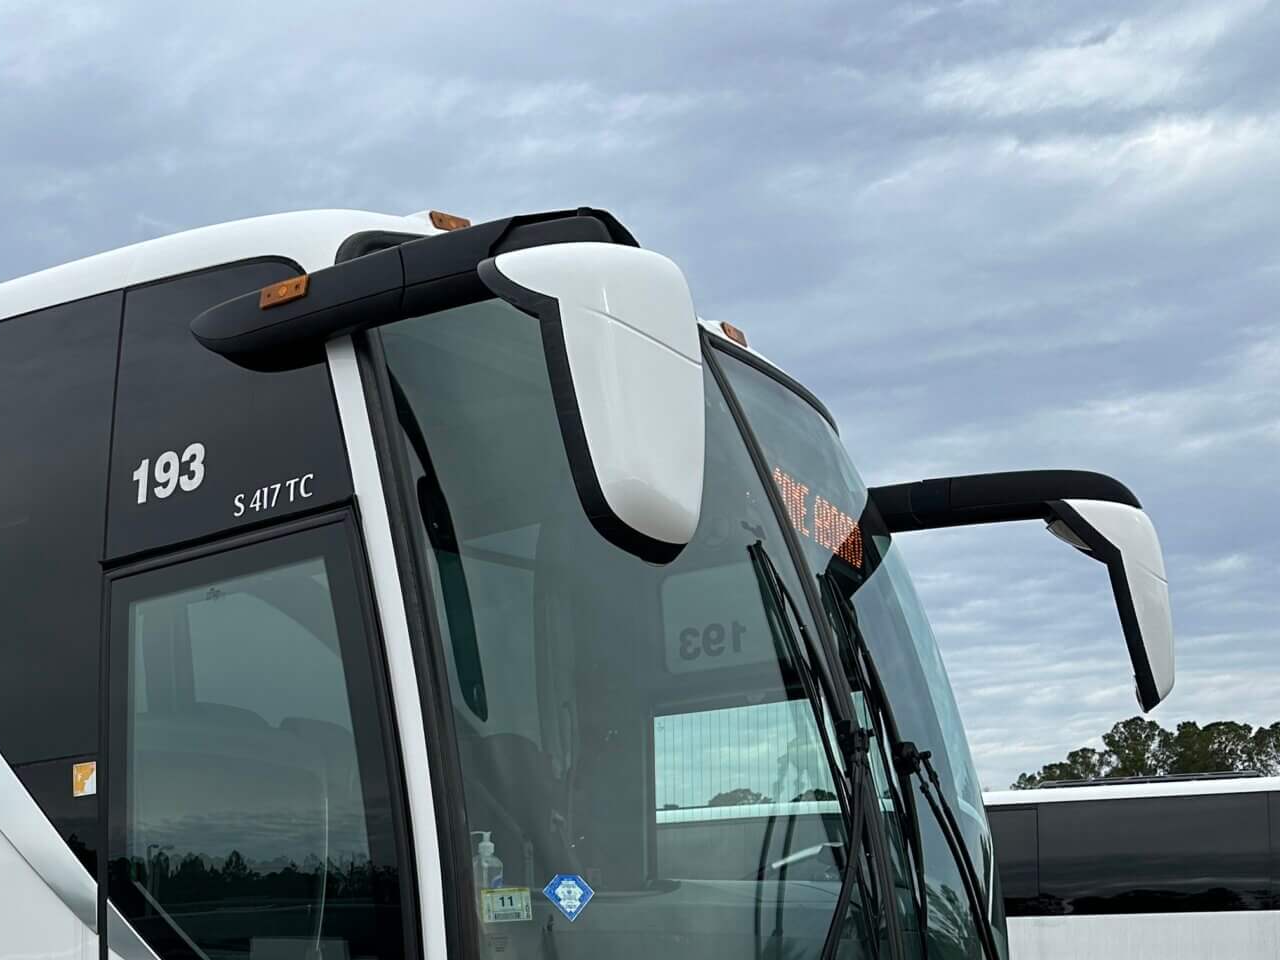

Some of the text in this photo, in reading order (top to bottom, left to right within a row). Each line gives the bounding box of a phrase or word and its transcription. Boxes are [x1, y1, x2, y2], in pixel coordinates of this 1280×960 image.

[132, 442, 206, 505] 193
[233, 473, 314, 517] S 417 TC
[499, 895, 514, 907] 11
